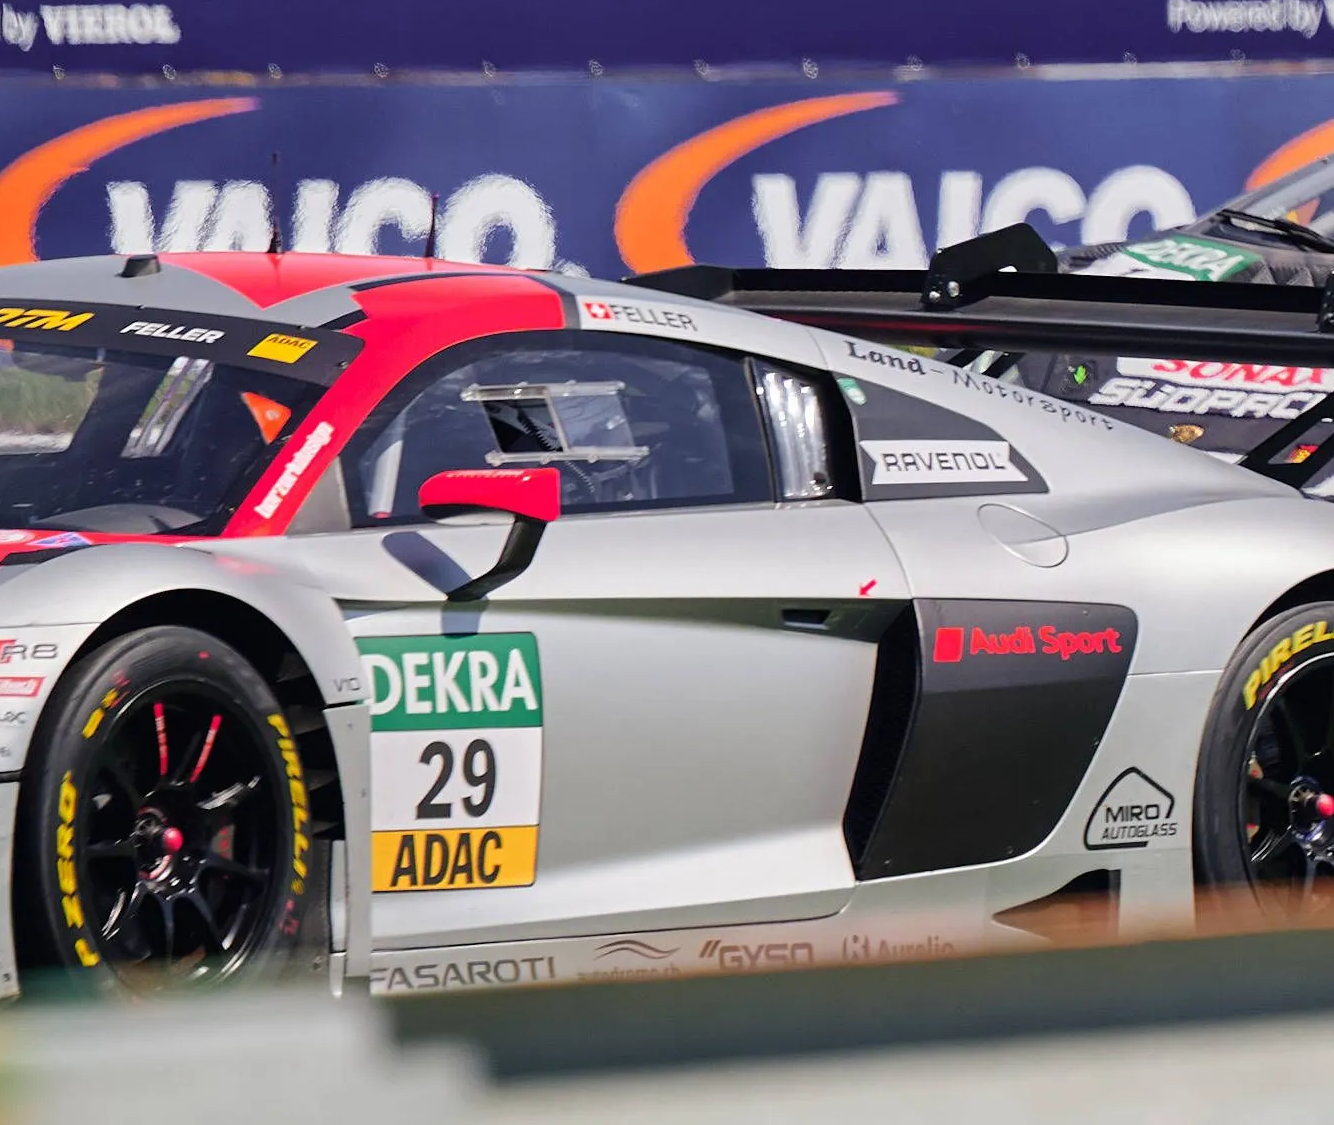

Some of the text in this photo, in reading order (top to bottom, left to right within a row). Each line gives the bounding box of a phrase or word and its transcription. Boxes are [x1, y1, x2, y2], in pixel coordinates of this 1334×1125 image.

[2, 3, 38, 52] by
[39, 4, 181, 45] VIEROL
[119, 320, 226, 345] FELLER
[609, 303, 699, 332] FELLER
[881, 452, 1008, 472] RAVENOL
[969, 624, 1123, 661] Audi Sport
[368, 648, 539, 716] DEKRA
[267, 713, 310, 879] PIRELLI
[415, 738, 497, 820] 29
[1100, 822, 1179, 842] AUTOGLASS
[1105, 803, 1161, 824] MIRO
[389, 831, 504, 889] ADAC
